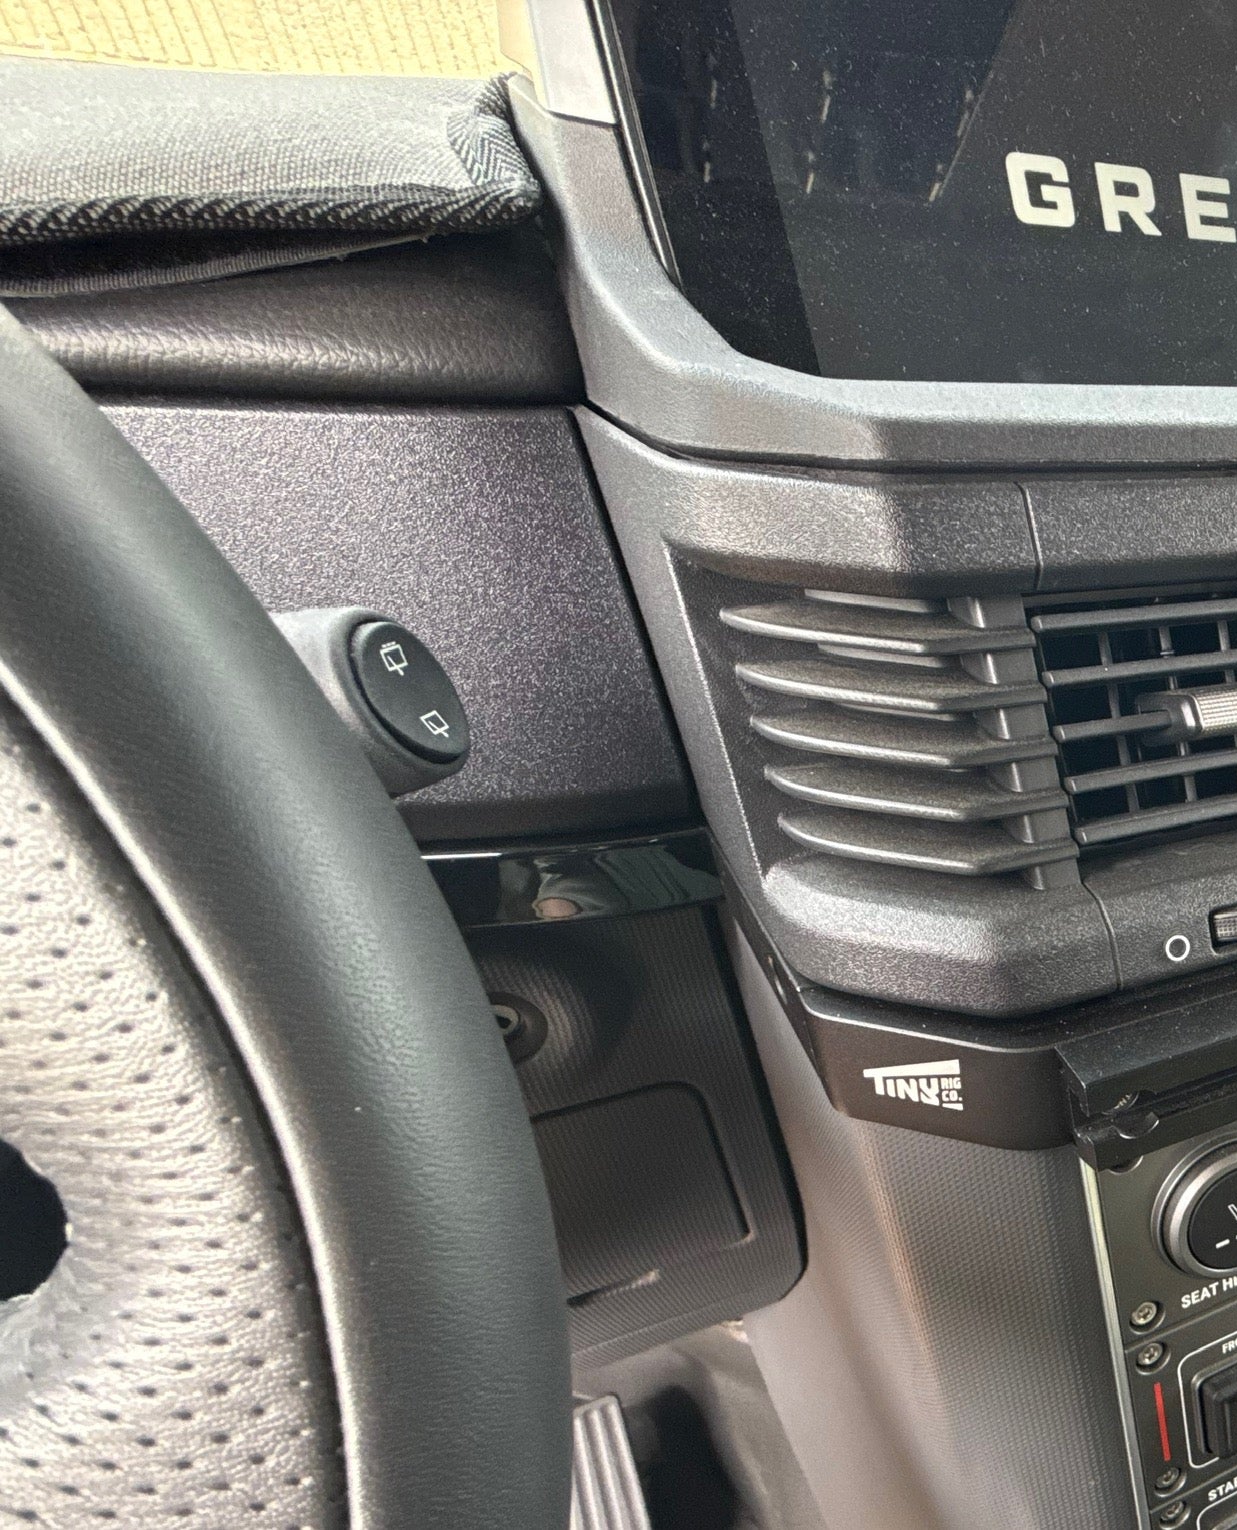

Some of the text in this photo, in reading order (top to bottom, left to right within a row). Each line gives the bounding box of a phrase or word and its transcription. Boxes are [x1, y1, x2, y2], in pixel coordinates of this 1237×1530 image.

[940, 1077, 962, 1089] RIG
[941, 1090, 963, 1102] CO.
[1180, 1281, 1221, 1309] SEAT
